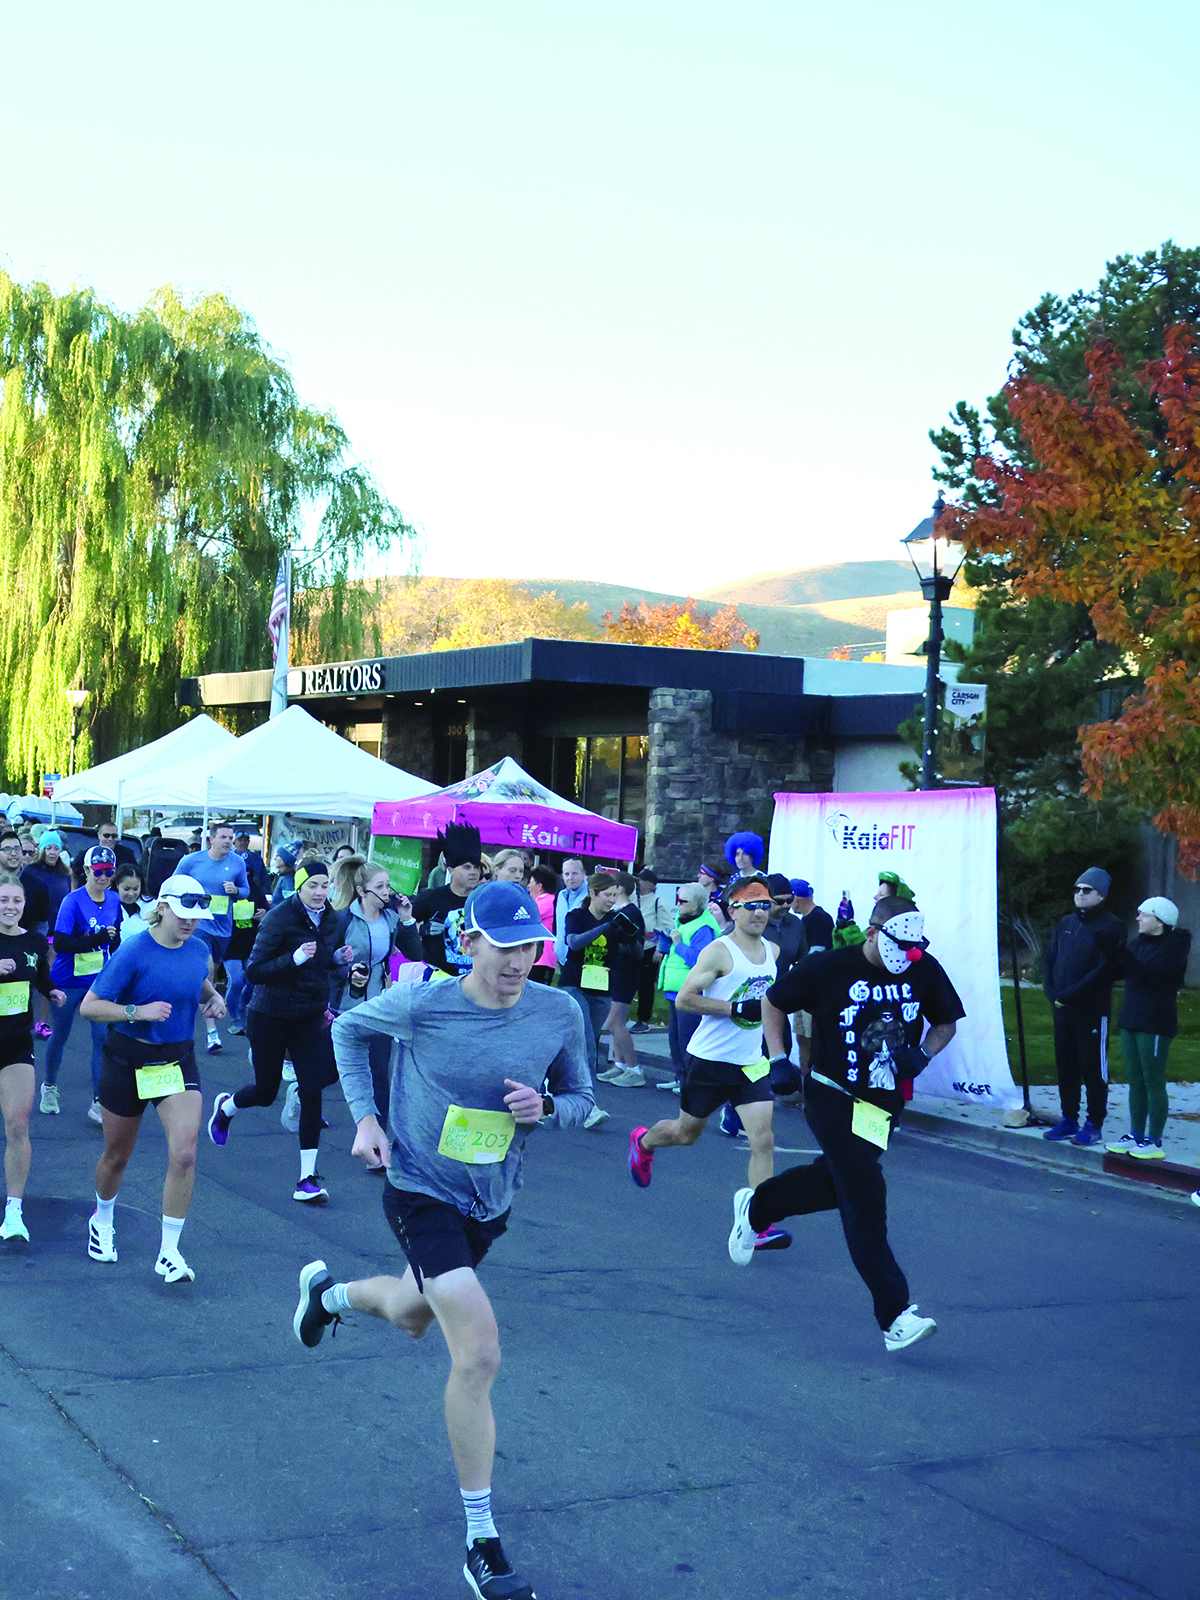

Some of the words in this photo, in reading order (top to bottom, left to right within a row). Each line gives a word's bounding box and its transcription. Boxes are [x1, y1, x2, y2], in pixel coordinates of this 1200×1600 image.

[304, 662, 382, 695] REALTORS
[951, 691, 980, 700] CARSON
[521, 823, 600, 852] KaiaFIT
[842, 823, 916, 850] KaiaFIT
[5, 992, 28, 1006] 308
[848, 979, 913, 1003] Gone
[156, 1072, 181, 1085] 202
[868, 1120, 885, 1137] 155
[470, 1130, 509, 1149] 203
